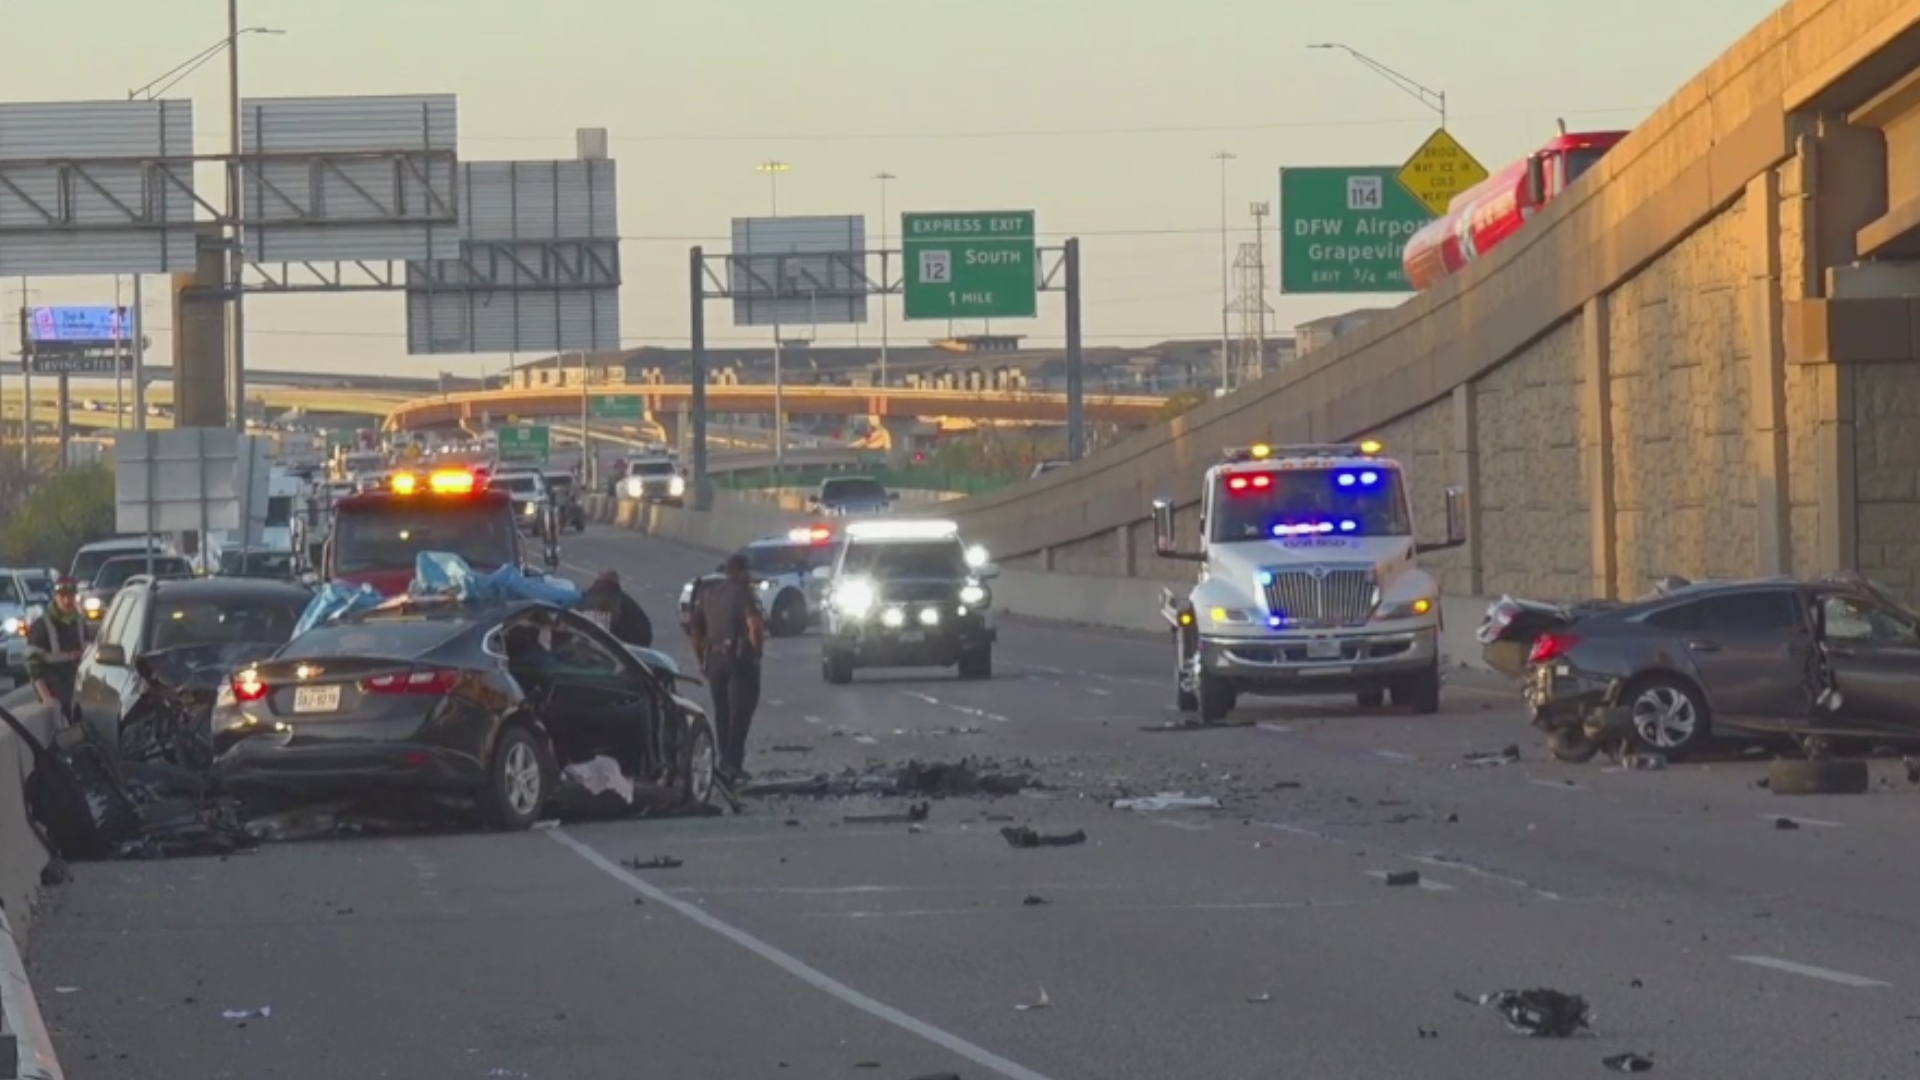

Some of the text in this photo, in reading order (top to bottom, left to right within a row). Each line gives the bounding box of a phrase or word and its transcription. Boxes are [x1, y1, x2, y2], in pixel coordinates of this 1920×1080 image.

[1414, 162, 1432, 172] MAY
[1440, 162, 1455, 172] ICE
[1431, 175, 1456, 187] COLD
[1351, 188, 1377, 207] 114
[913, 216, 1024, 233] EXPRESS EXIT
[1295, 217, 1432, 239] DFW Airpor
[1309, 241, 1404, 264] Grapevin
[925, 262, 945, 280] 12
[1312, 270, 1341, 283] EXIT
[948, 291, 993, 306] 1 MILE
[39, 360, 82, 371] IRVING
